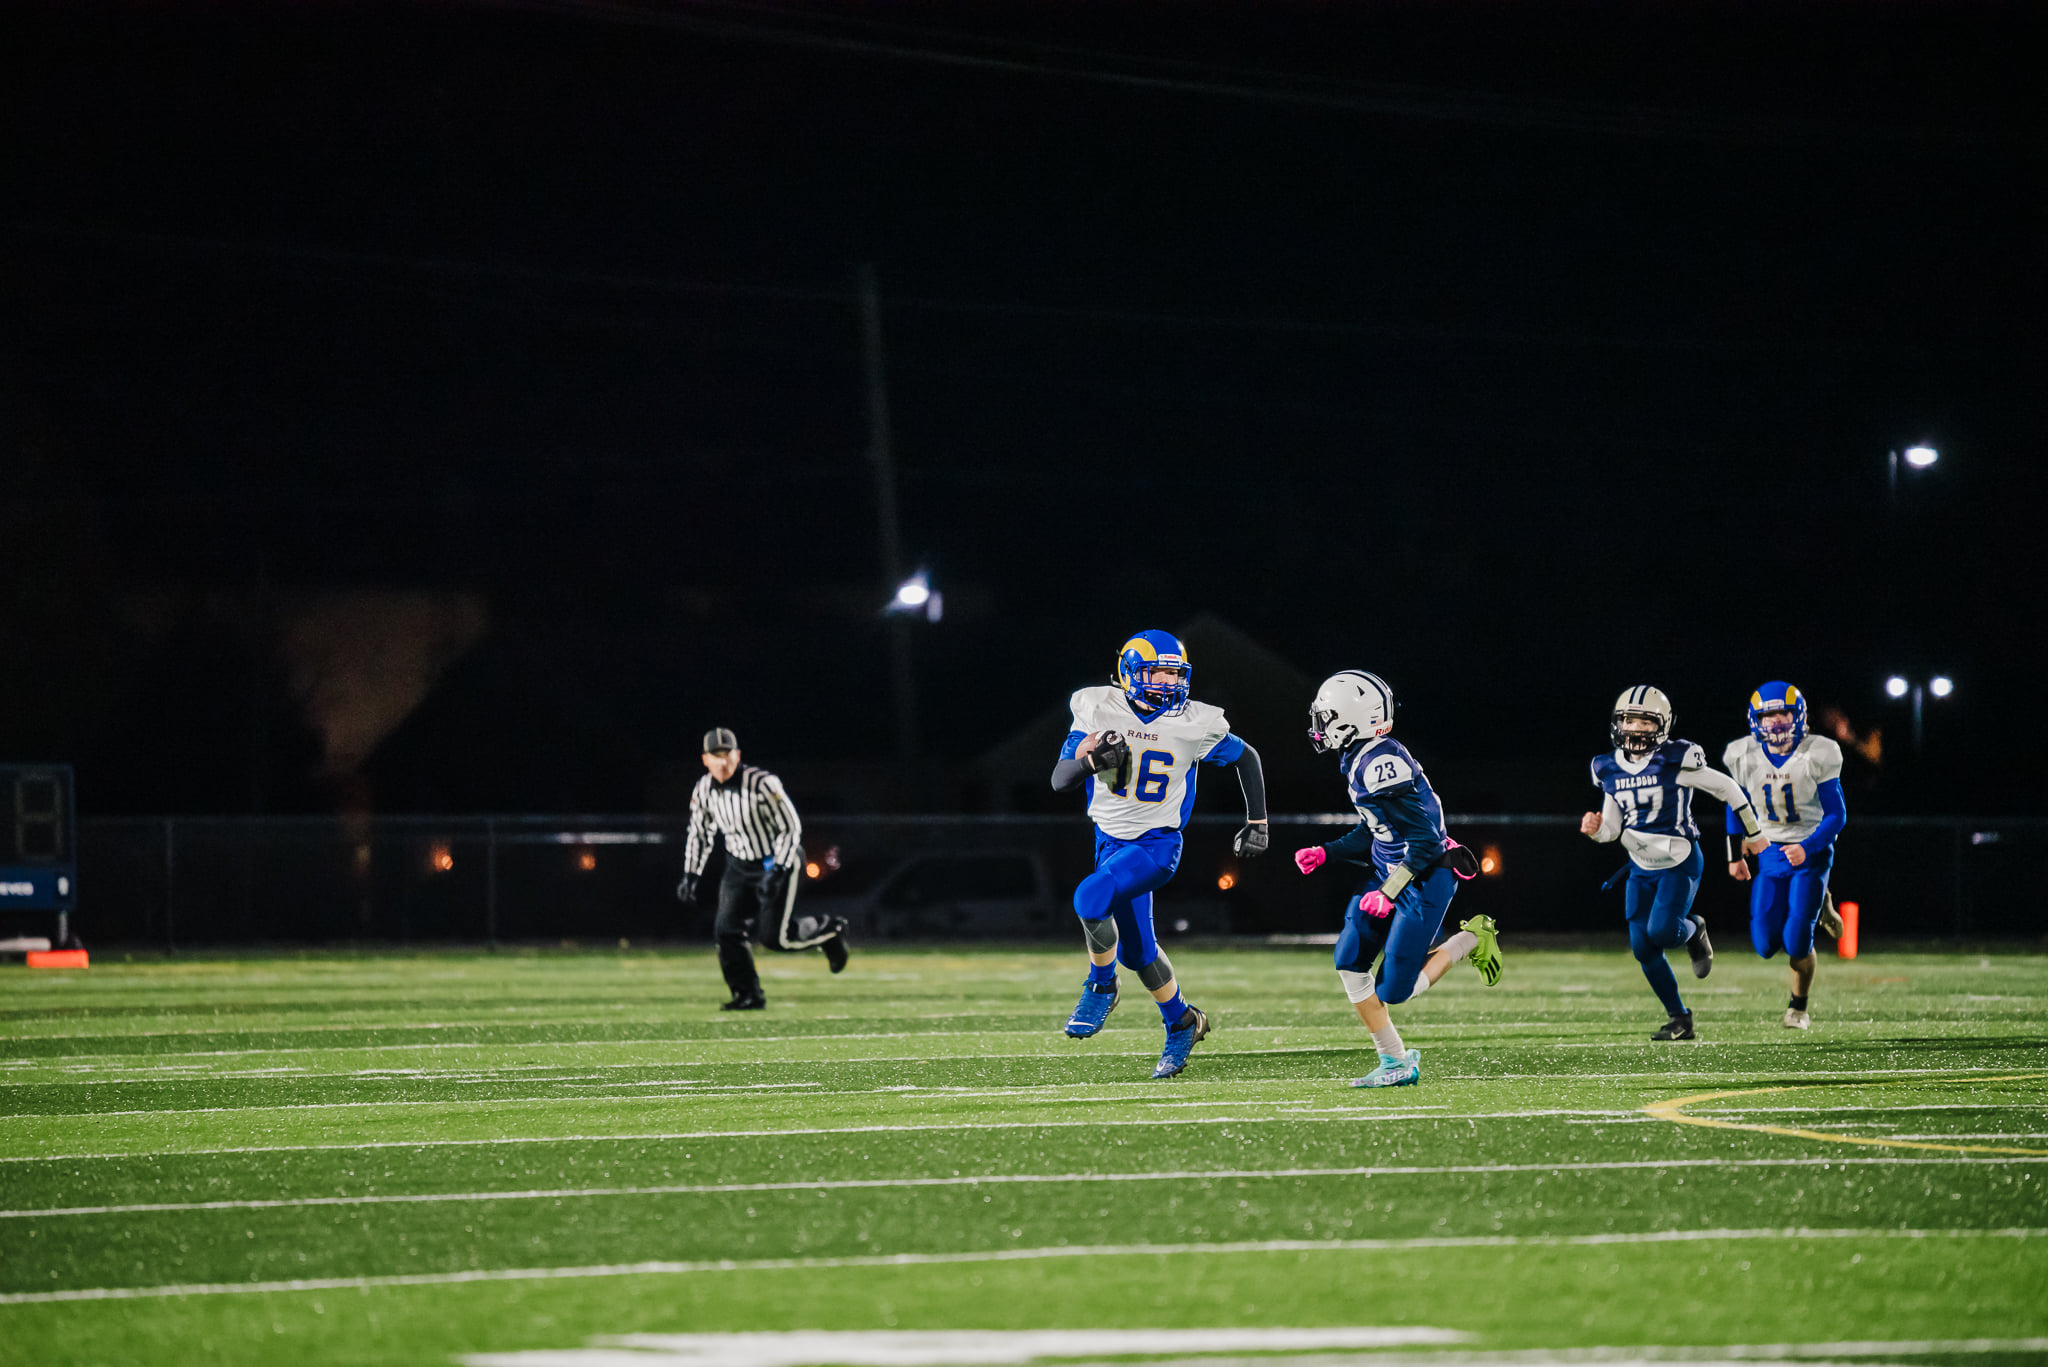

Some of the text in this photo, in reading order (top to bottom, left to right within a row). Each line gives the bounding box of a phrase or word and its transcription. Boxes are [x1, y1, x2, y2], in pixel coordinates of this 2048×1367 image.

[1127, 729, 1158, 741] RAMS
[1374, 761, 1398, 783] 23
[1761, 783, 1801, 824] 11
